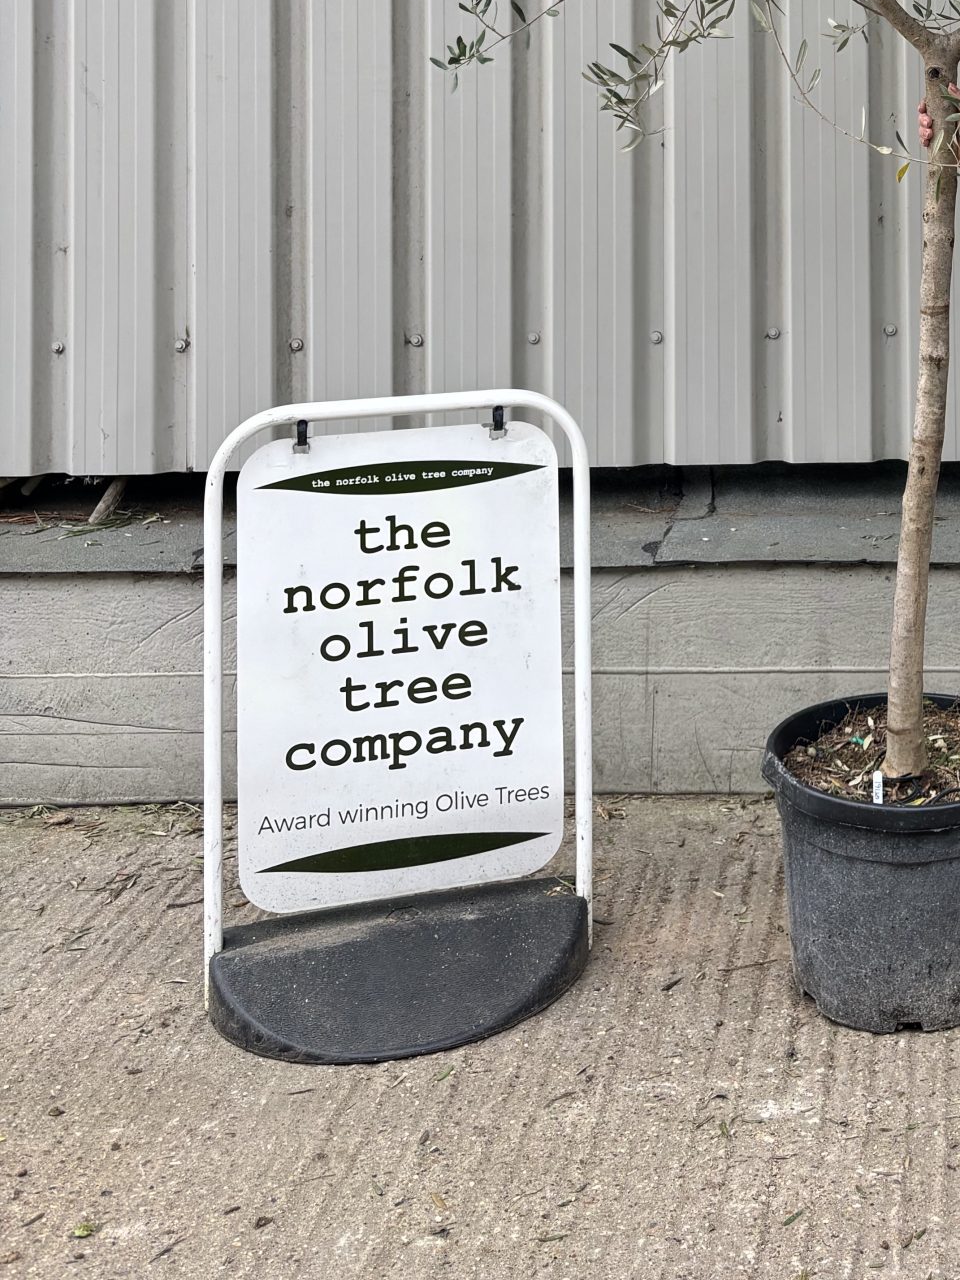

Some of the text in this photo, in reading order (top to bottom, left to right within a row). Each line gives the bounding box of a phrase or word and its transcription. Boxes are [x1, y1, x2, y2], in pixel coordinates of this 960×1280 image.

[311, 467, 494, 488] the norfolk olive tree company
[353, 514, 451, 554] the
[283, 556, 522, 614] norfolk
[320, 617, 488, 662] olive
[339, 672, 472, 712] tree
[285, 717, 525, 771] company
[257, 785, 550, 836] Award winning Olive Trees
